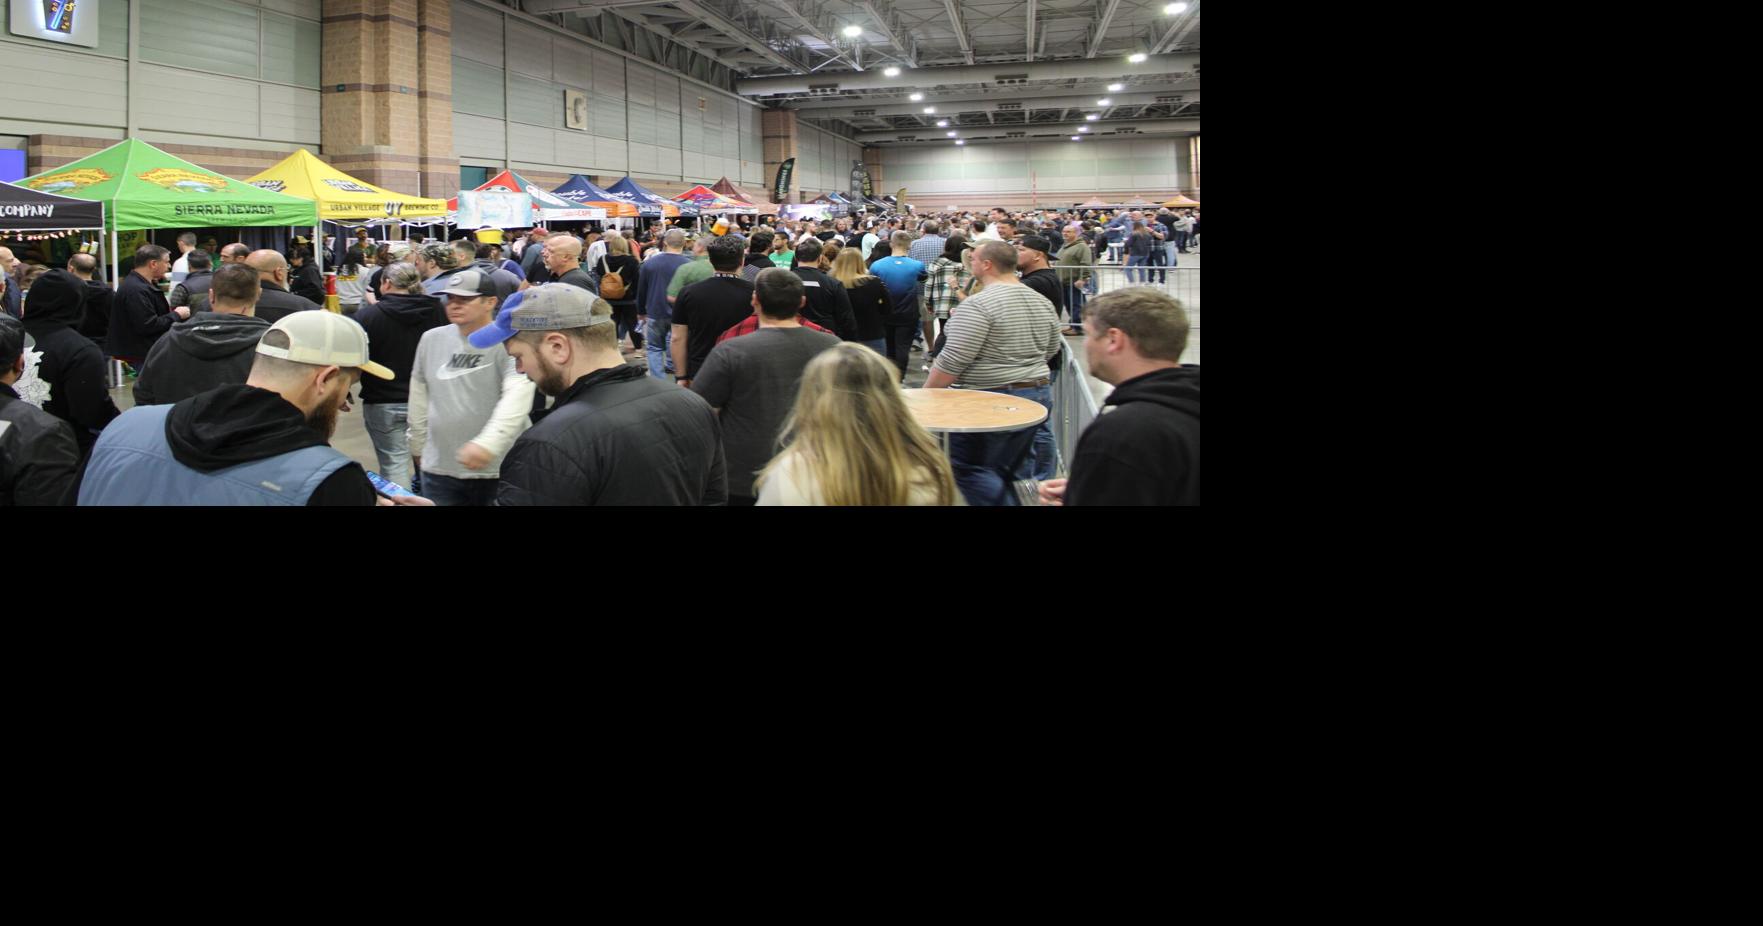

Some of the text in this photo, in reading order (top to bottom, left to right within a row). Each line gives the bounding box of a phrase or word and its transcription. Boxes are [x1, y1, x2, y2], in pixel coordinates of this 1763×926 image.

[0, 204, 54, 217] COMPANY
[175, 205, 275, 216] SIERRA NEVADA
[330, 203, 352, 211] URBAN
[354, 204, 380, 212] VILLAGE
[446, 353, 485, 368] NIKE
